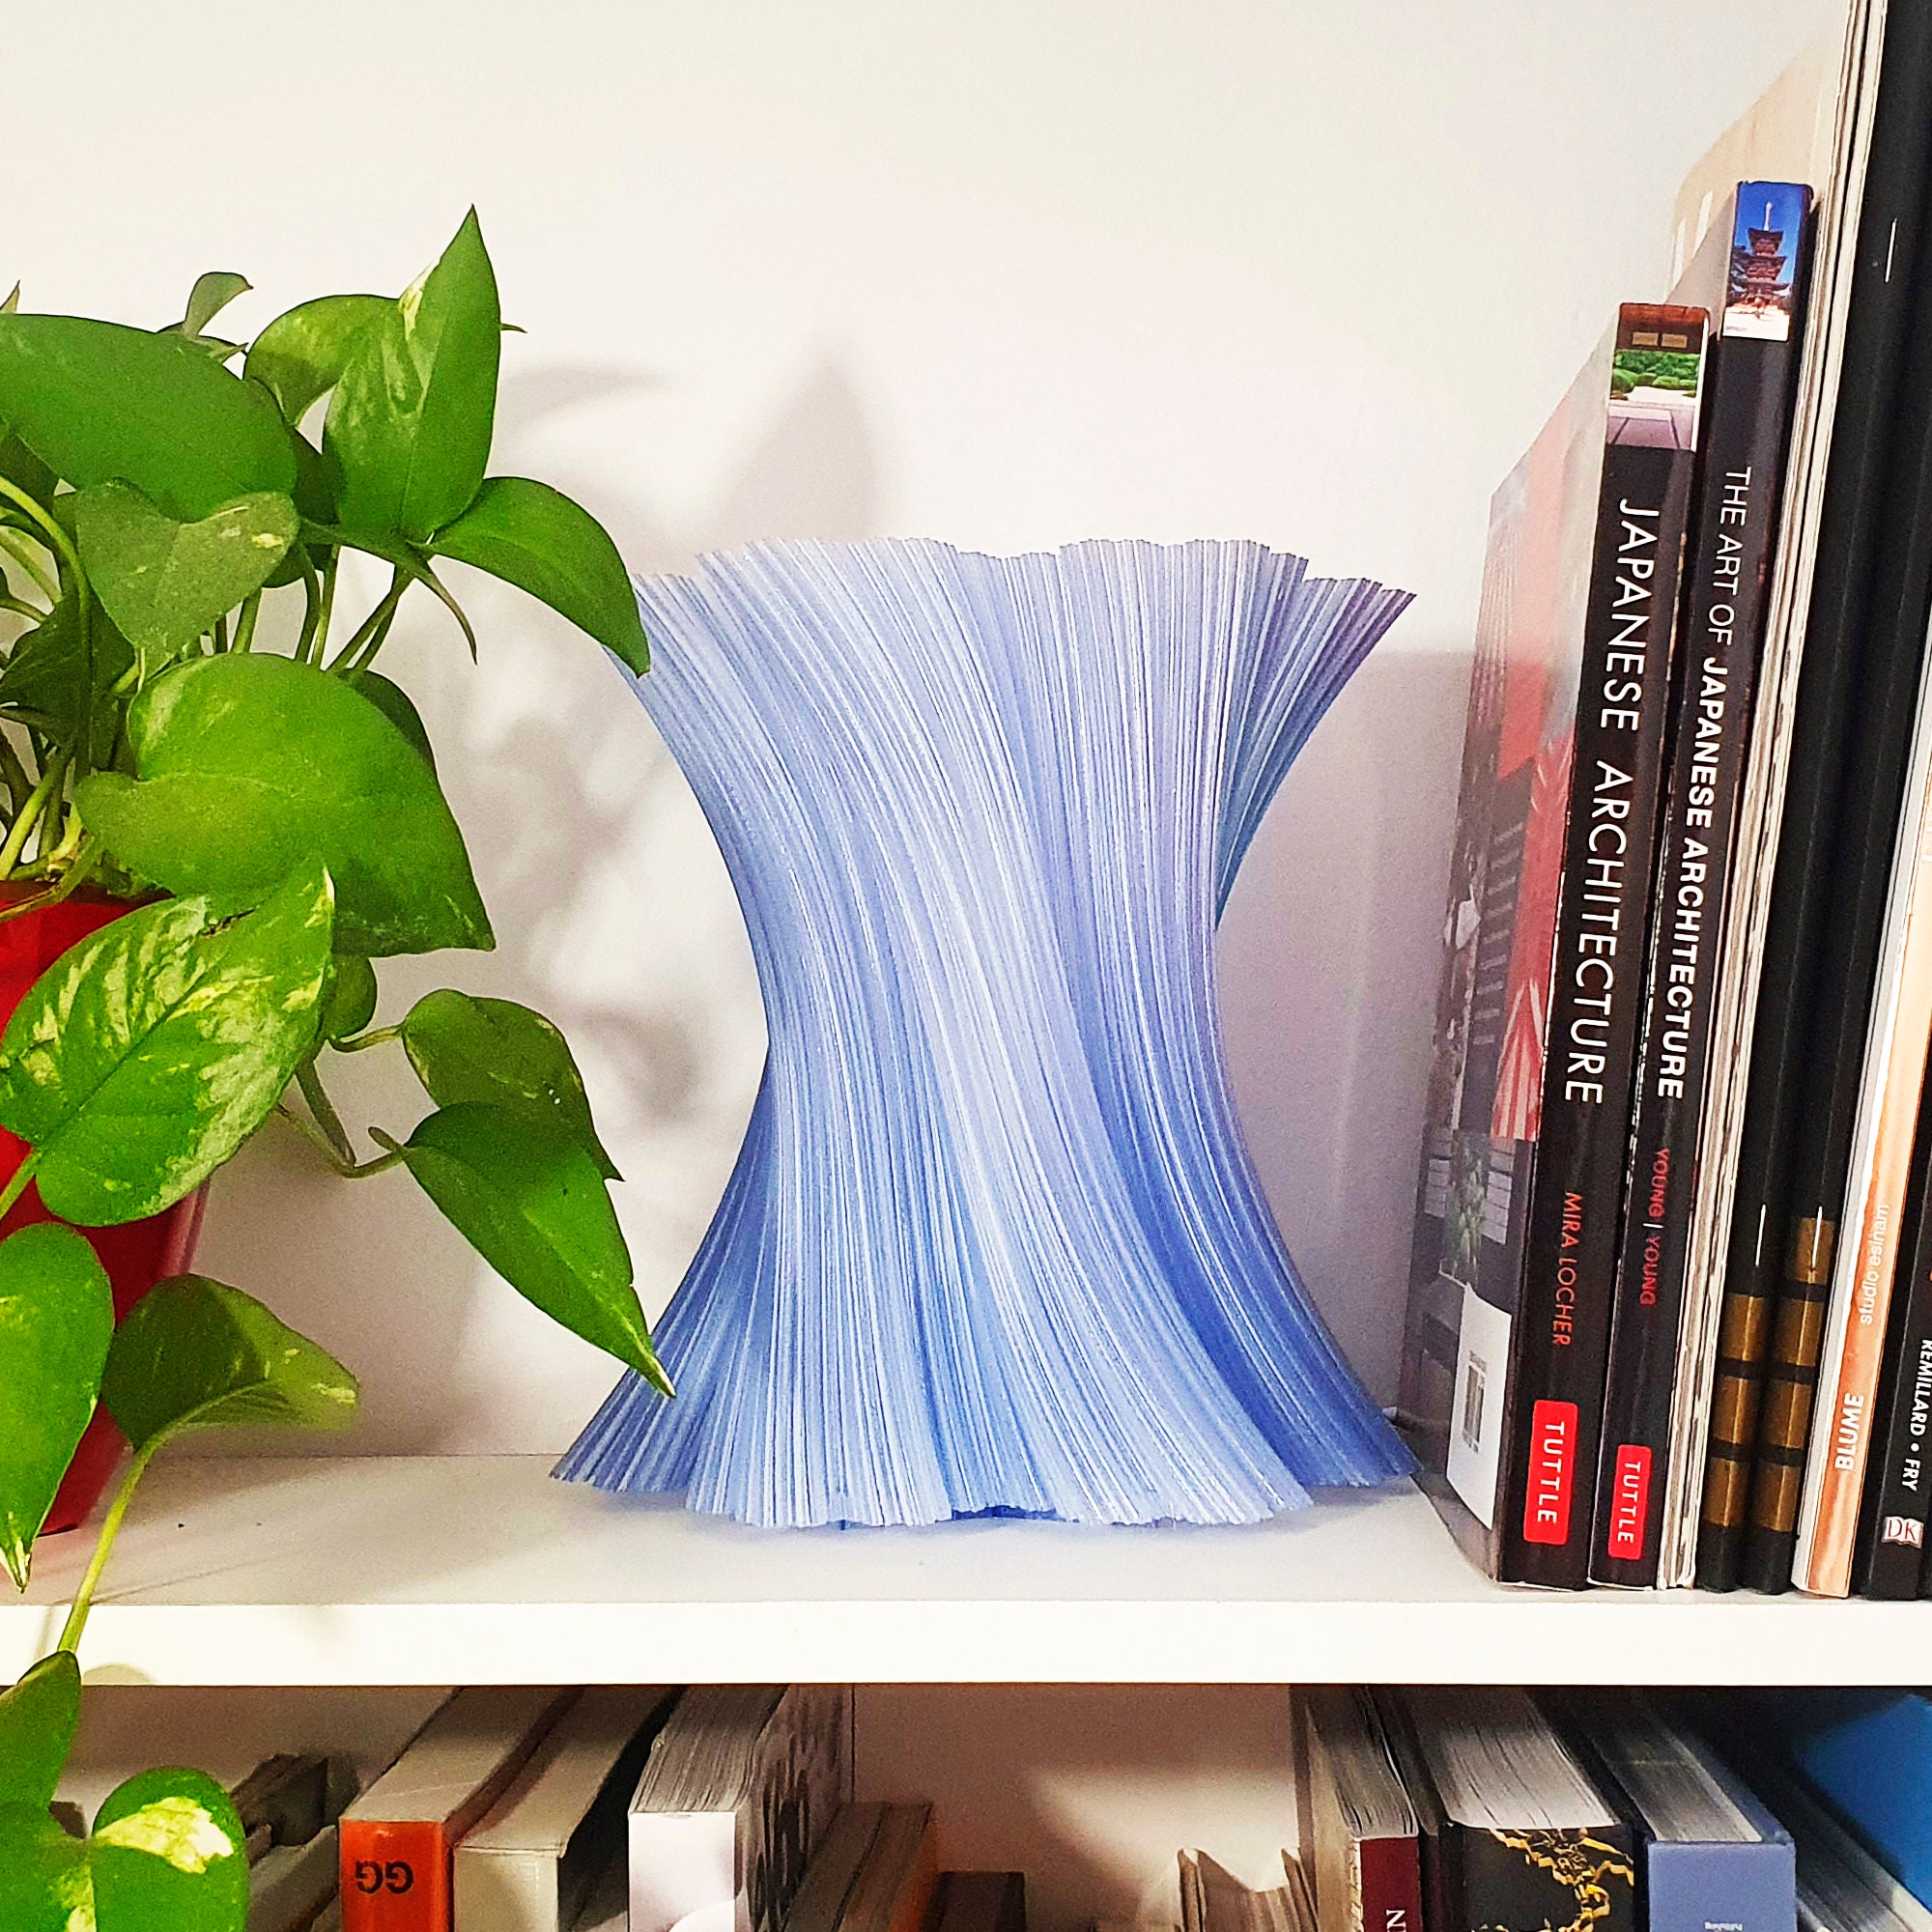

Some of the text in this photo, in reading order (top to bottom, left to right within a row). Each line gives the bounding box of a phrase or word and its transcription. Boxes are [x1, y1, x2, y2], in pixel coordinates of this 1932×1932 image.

[1564, 498, 1660, 1104] JAPANESE ARCHITECTURE
[1658, 466, 1752, 1099] THE ART OF JAPANESE ARCHITECTURE
[1551, 1192, 1584, 1346] MIRA LOCHER
[1639, 1148, 1671, 1306] YOUNG YOUNG
[1859, 1270, 1880, 1326] studio
[1834, 1392, 1864, 1470] BLUME
[1901, 1339, 1932, 1492] REMILLARD FRY
[1537, 1421, 1566, 1523] TUTTLE
[1616, 1460, 1642, 1544] TUTTLE
[1887, 1519, 1918, 1542] DK
[355, 1861, 414, 1894] GG
